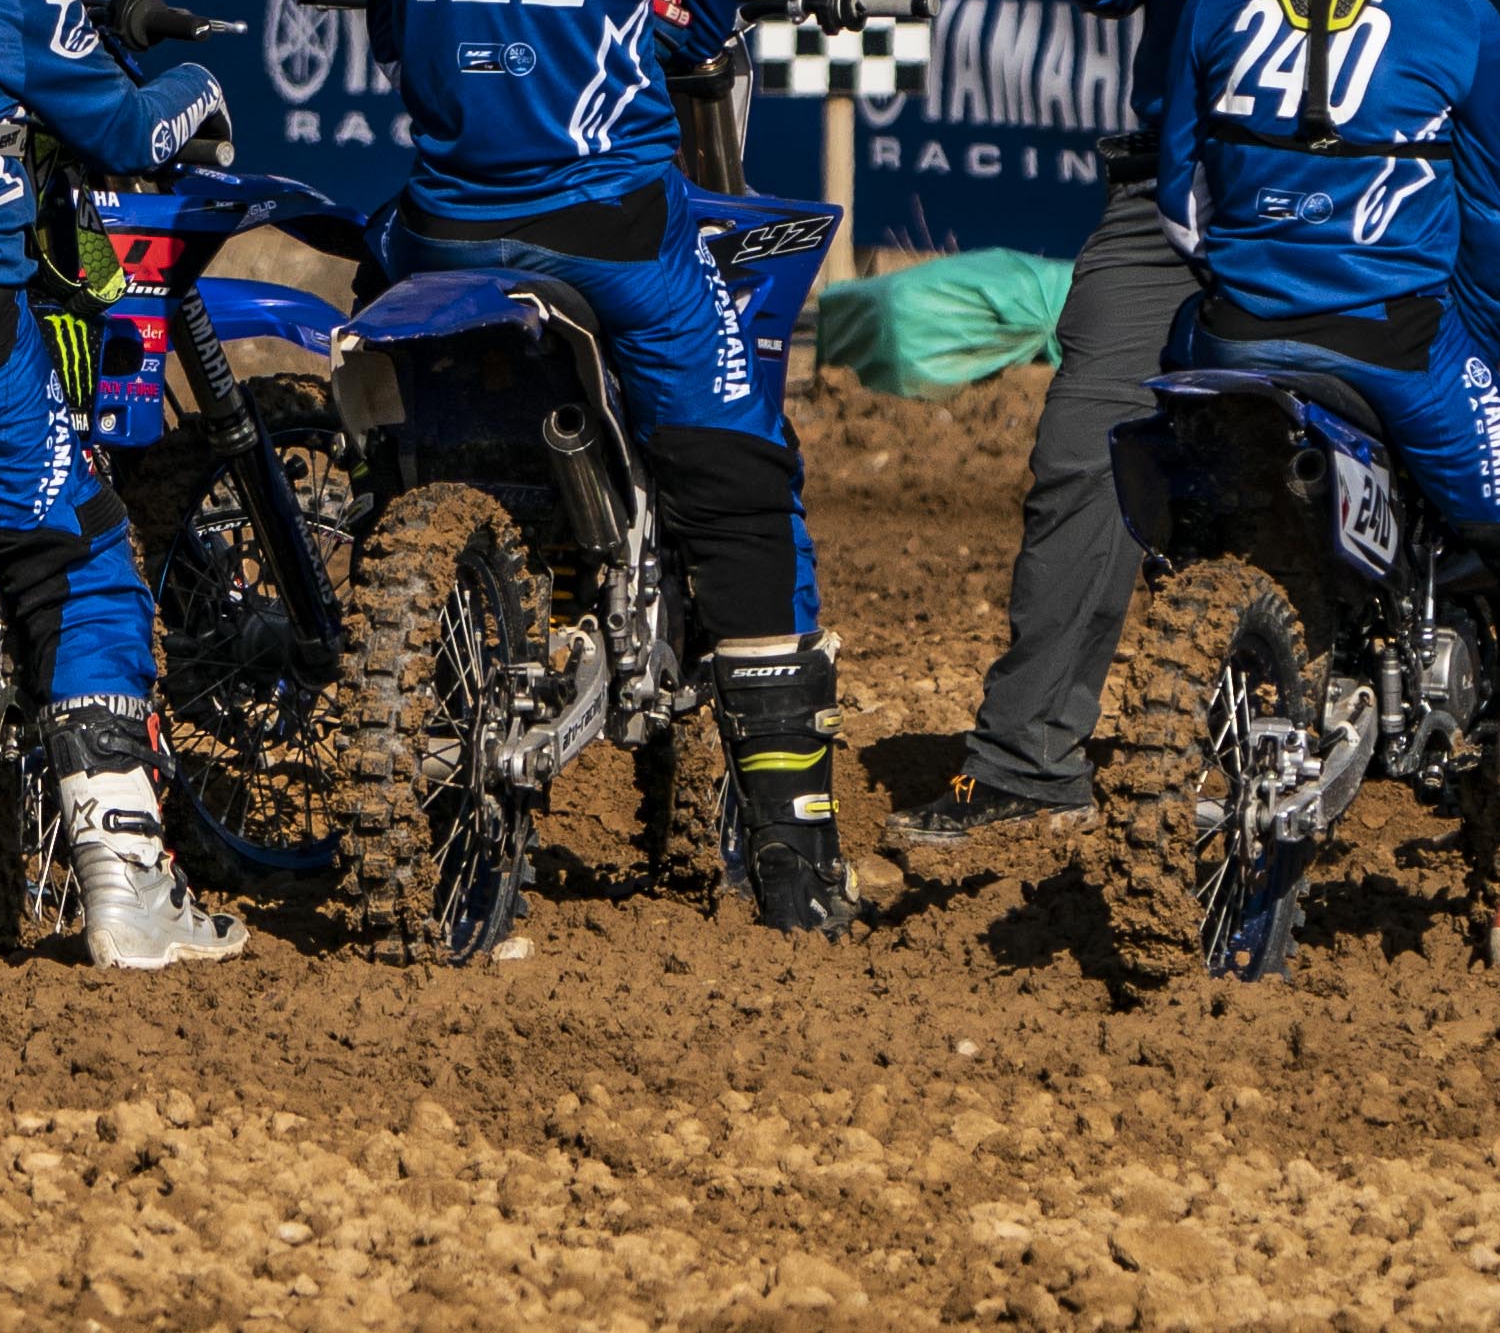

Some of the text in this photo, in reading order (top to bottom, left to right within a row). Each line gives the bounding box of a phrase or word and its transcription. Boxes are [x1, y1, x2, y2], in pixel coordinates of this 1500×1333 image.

[869, 136, 1099, 183] RACIN
[182, 283, 235, 401] YAMAHA
[712, 268, 752, 404] YAMAHA
[731, 665, 801, 678] SCOTT
